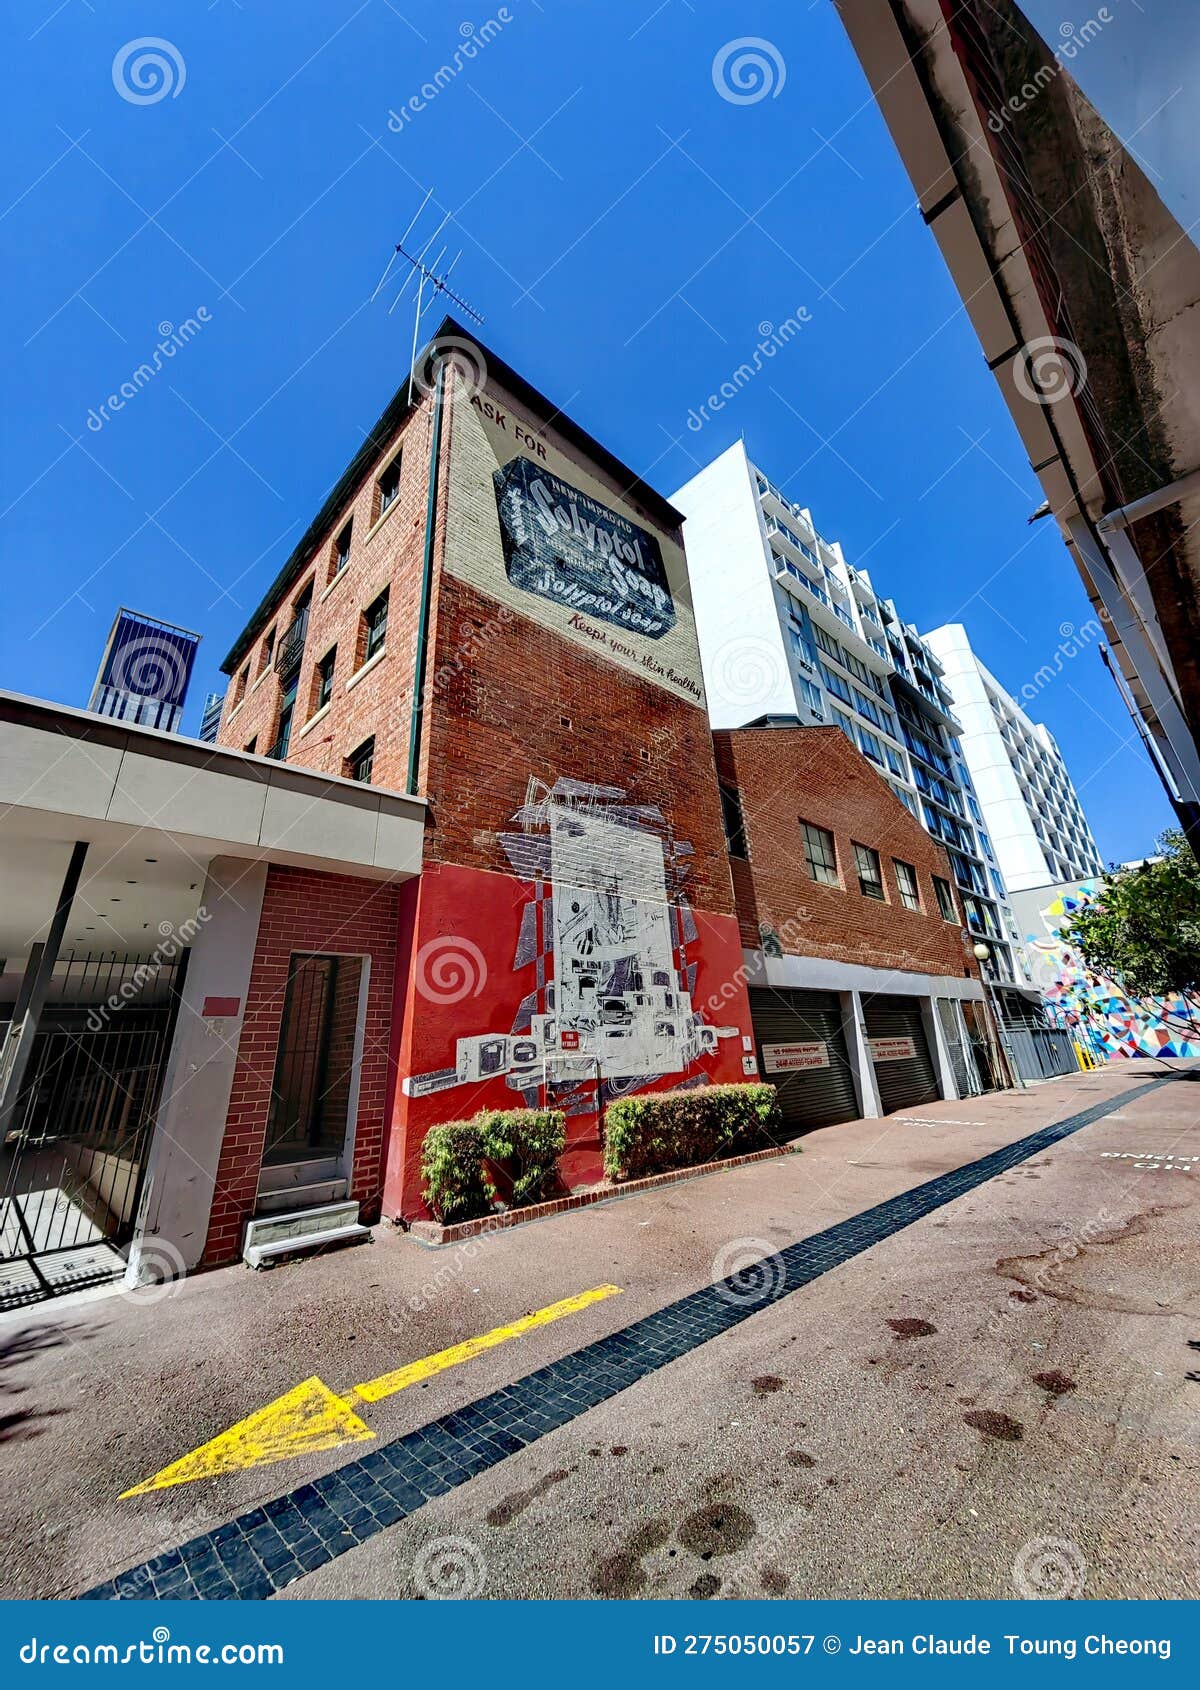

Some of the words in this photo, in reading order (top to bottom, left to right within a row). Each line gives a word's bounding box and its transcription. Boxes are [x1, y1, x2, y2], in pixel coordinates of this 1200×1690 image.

[470, 394, 506, 431] ASK
[515, 424, 547, 460] FOR
[529, 478, 645, 571] Solyptol
[608, 554, 667, 610] Soap
[568, 612, 607, 644] Keeps
[610, 638, 637, 662] your
[640, 653, 665, 679] skin
[666, 668, 701, 700] healthy
